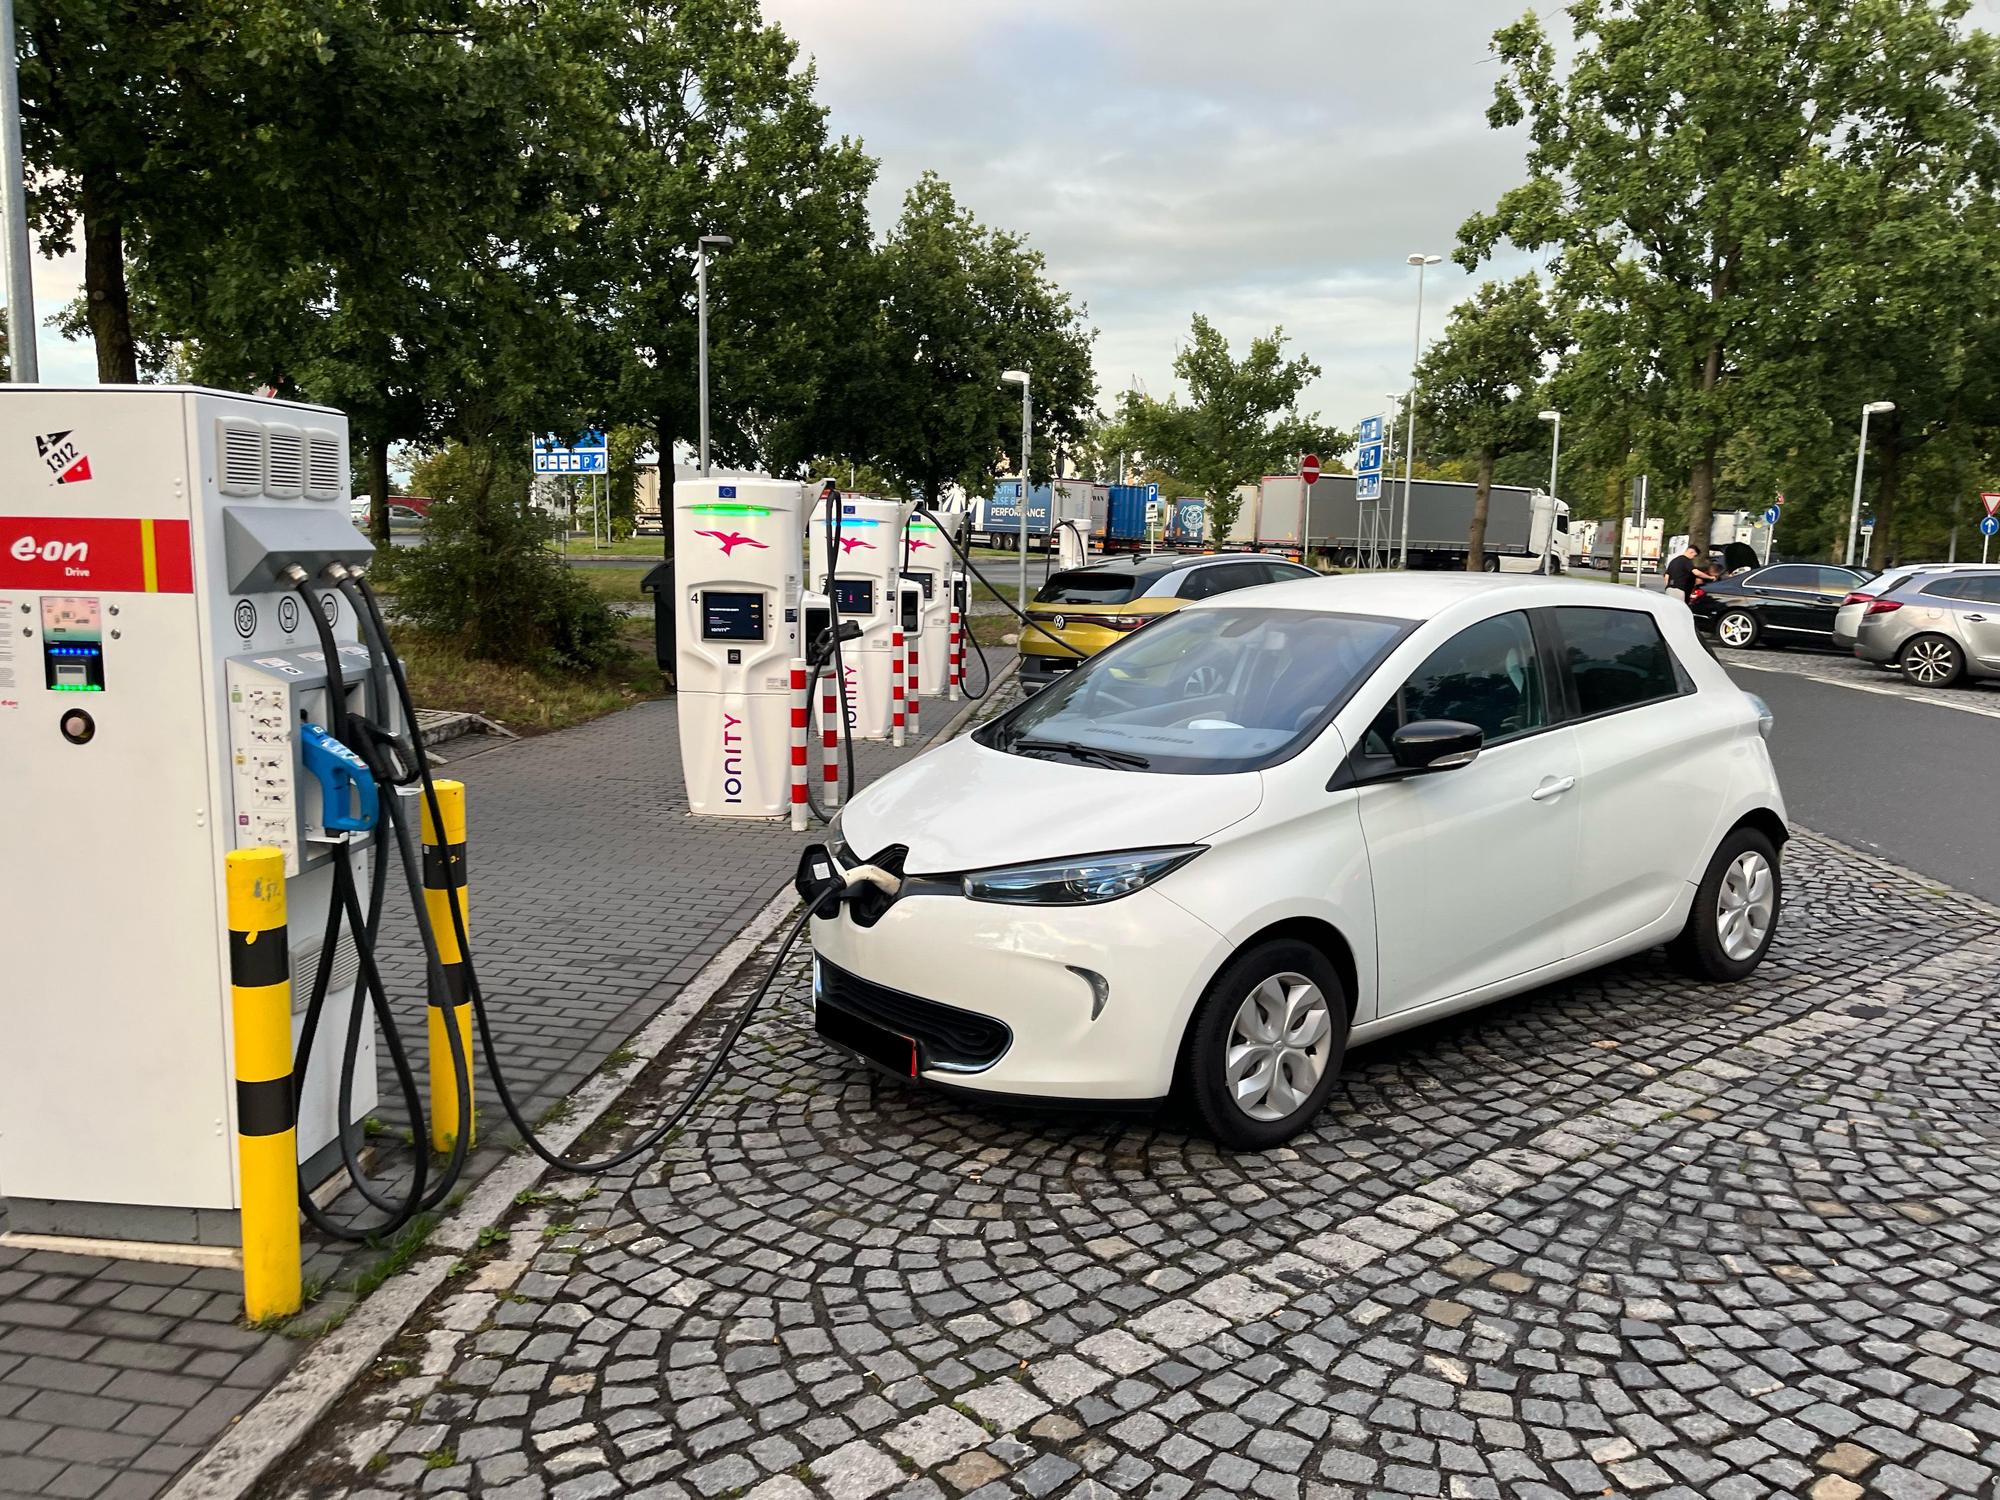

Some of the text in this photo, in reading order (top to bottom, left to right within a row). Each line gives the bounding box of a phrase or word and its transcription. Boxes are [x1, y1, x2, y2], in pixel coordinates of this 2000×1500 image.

[46, 442, 79, 473] 1312
[1149, 486, 1156, 500] P
[65, 567, 90, 577] Drive
[690, 592, 700, 604] 4
[724, 713, 742, 804] IONITY
